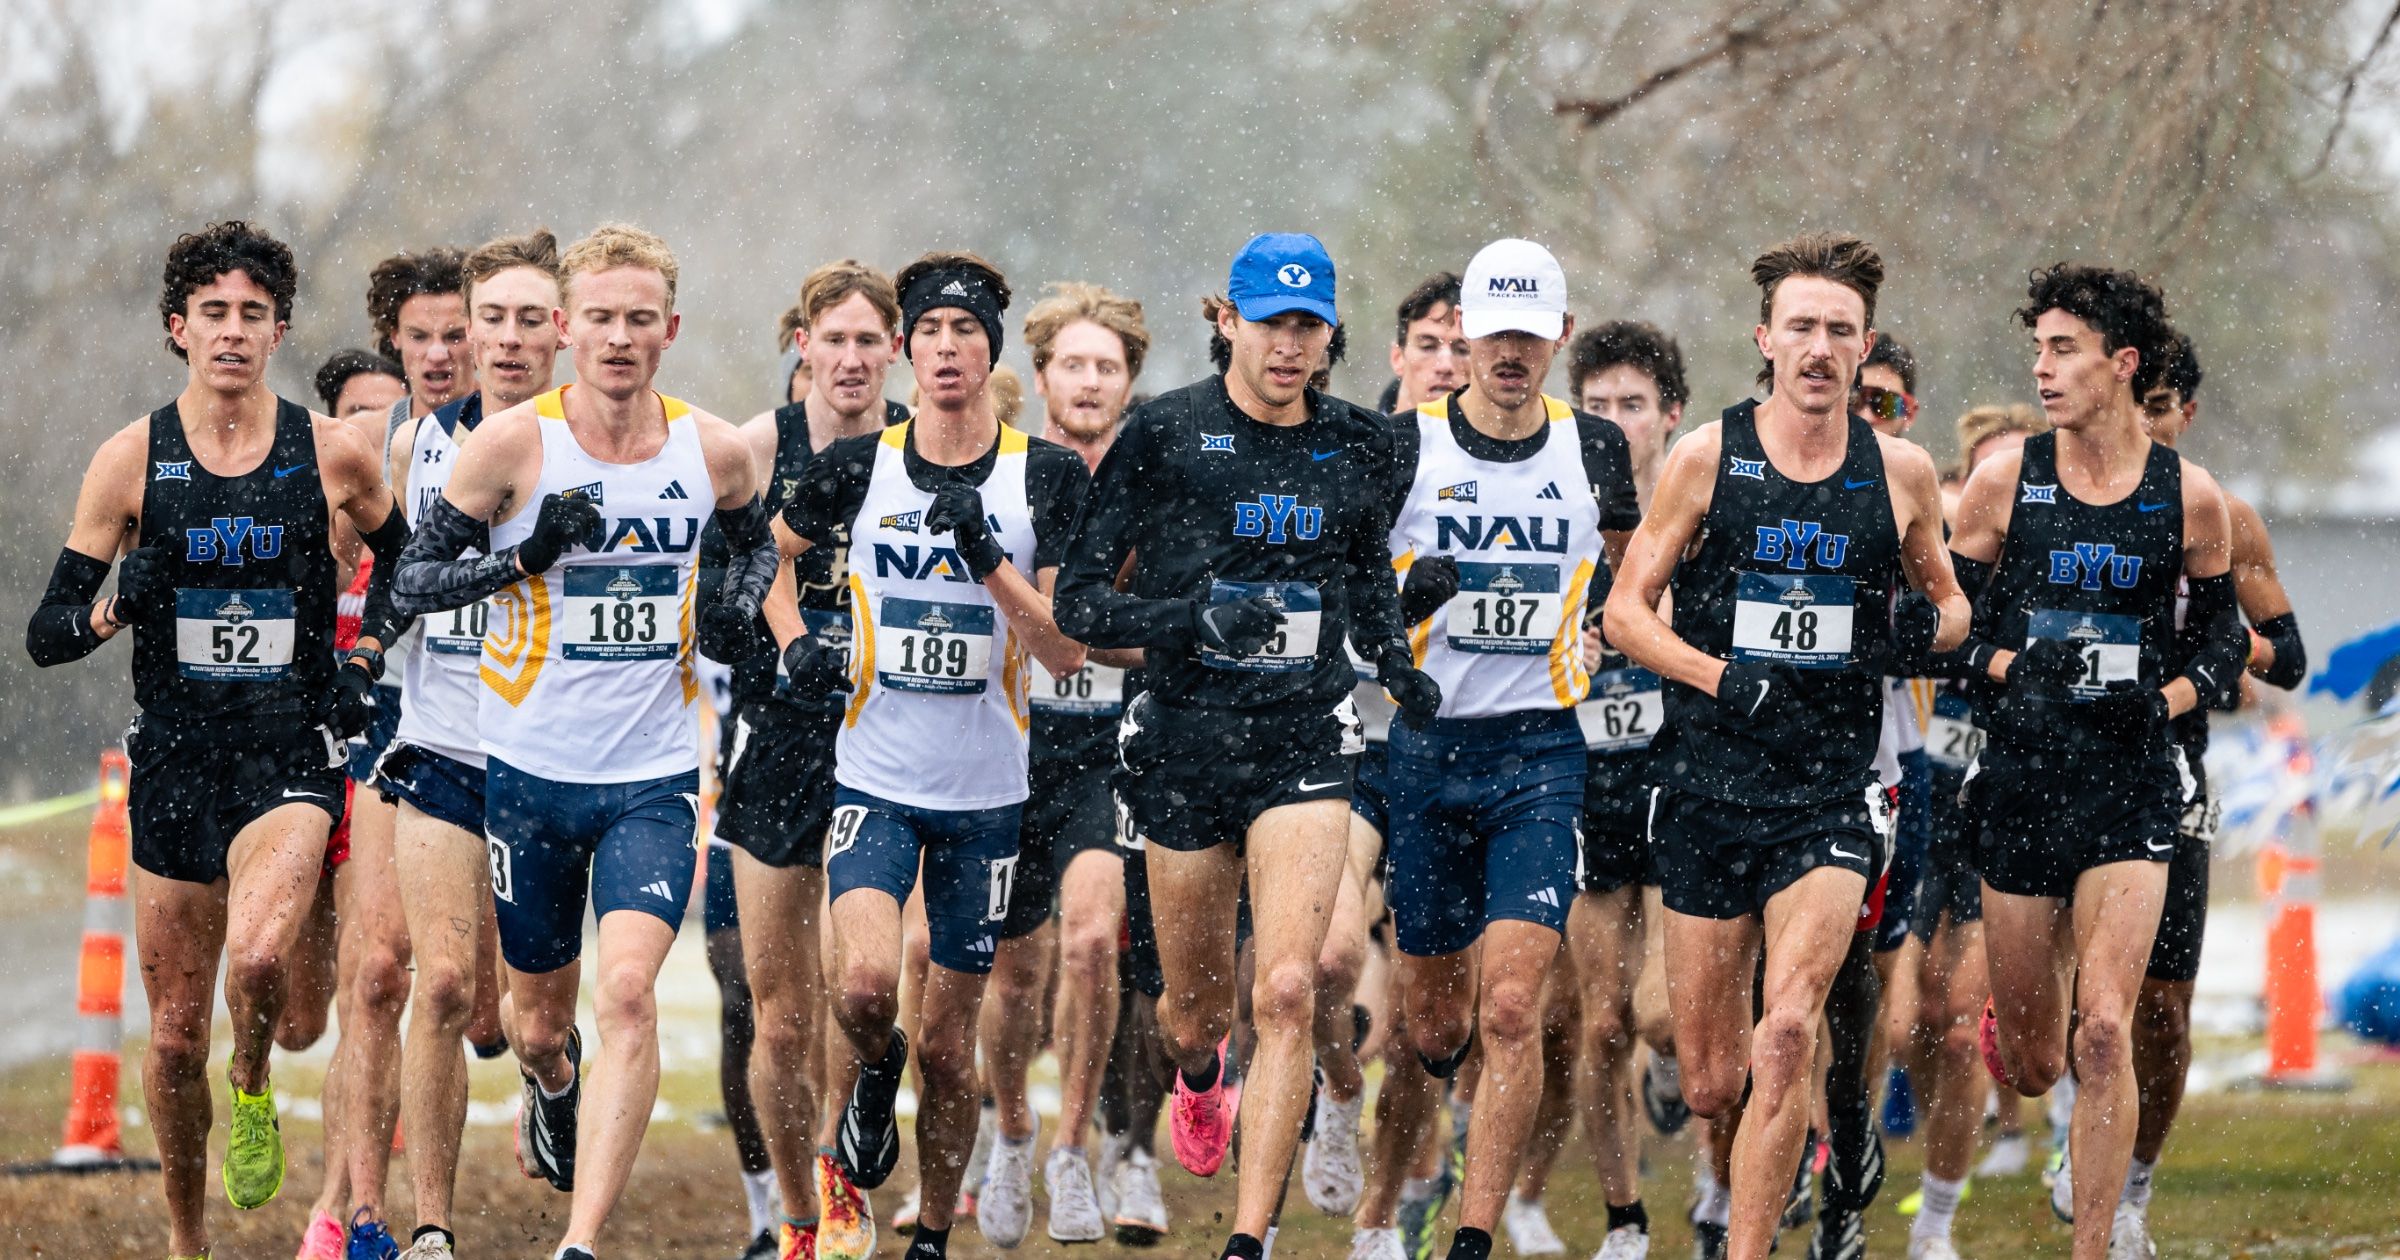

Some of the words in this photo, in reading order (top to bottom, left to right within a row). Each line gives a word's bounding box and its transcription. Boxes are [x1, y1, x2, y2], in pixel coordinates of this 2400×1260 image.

[1283, 266, 1306, 285] Y
[1489, 278, 1537, 292] NAU
[1233, 493, 1323, 544] BYU
[1435, 515, 1570, 555] NAU
[186, 516, 284, 566] BYU
[1753, 518, 1849, 570] BYU
[872, 543, 1014, 585] NA
[2048, 542, 2143, 591] BYU
[589, 602, 657, 643] 183
[1472, 598, 1540, 637] 187
[1769, 611, 1818, 651] 48
[212, 625, 260, 664] 52
[900, 635, 968, 677] 189
[1604, 701, 1645, 738] 62
[1944, 726, 1982, 760] 20
